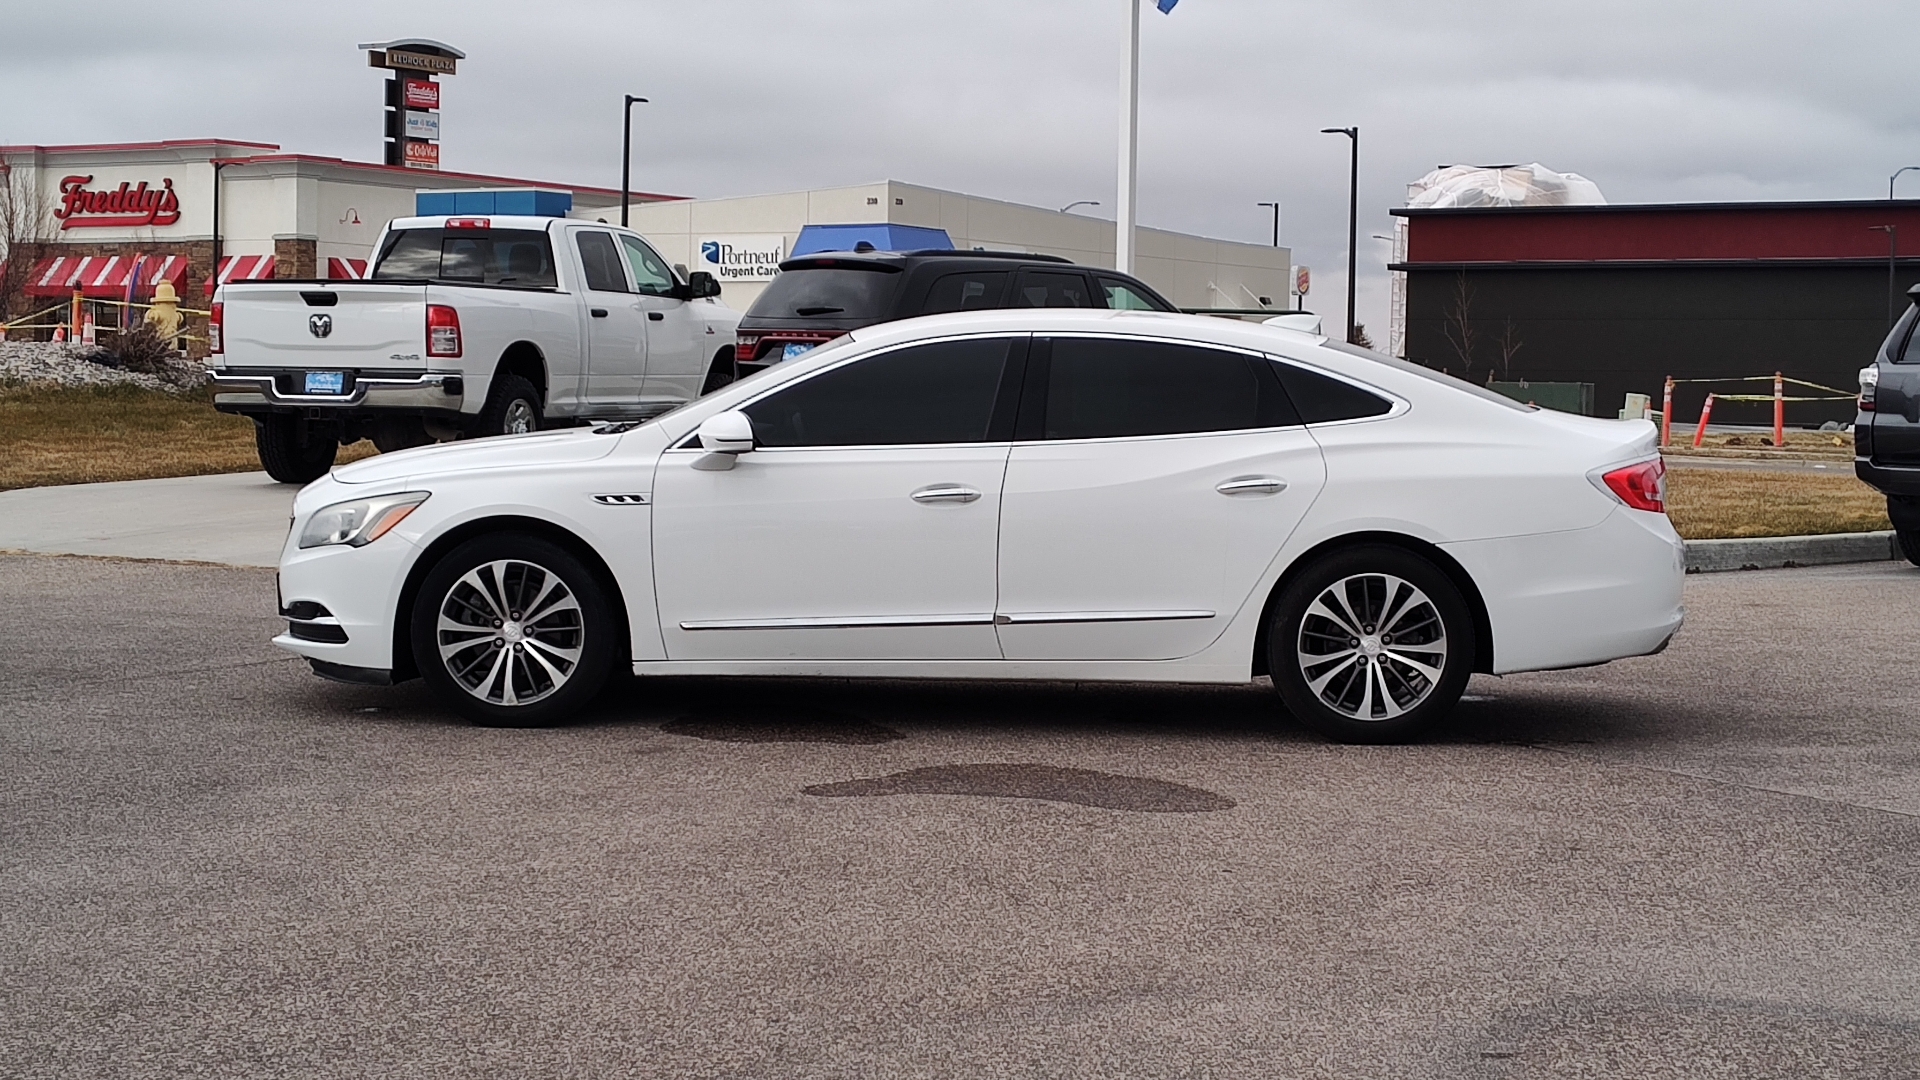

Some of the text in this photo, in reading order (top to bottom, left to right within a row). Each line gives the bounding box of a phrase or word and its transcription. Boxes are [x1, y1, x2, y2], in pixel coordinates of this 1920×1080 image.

[431, 59, 454, 70] PLAZA
[407, 83, 437, 100] Freddy's
[54, 175, 181, 230] Freddy's
[721, 244, 780, 264] Portneuf
[720, 266, 754, 277] Urgent
